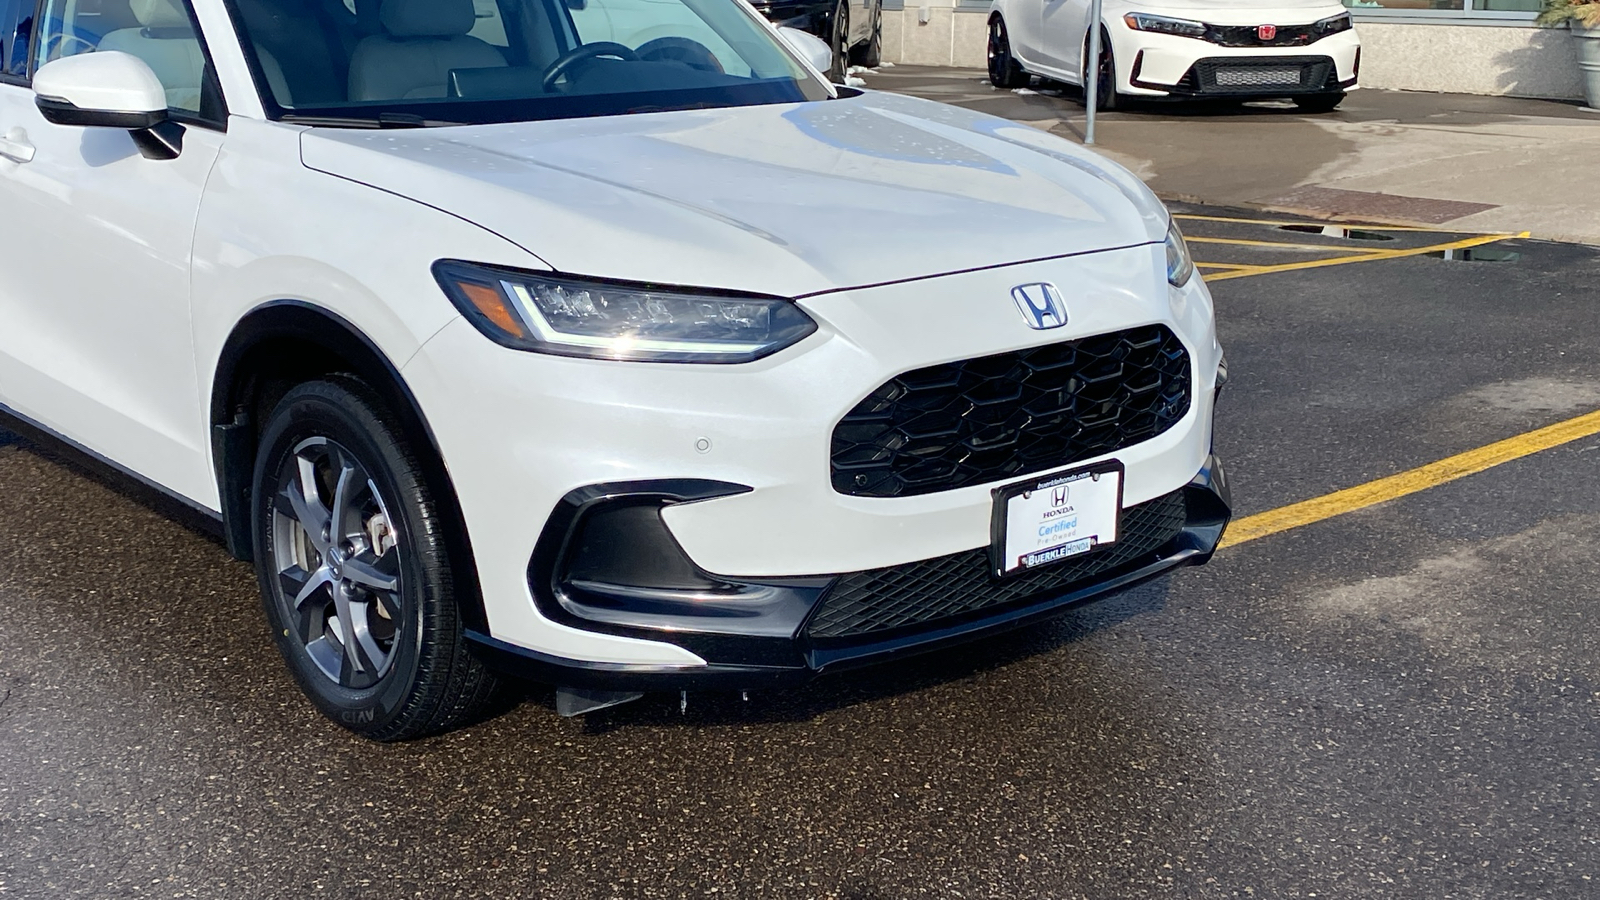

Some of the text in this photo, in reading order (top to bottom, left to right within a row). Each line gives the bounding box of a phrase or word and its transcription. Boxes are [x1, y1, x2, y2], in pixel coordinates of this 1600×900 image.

[1043, 506, 1074, 518] HONDA
[1039, 517, 1077, 536] Certified
[1067, 542, 1089, 554] HONDA
